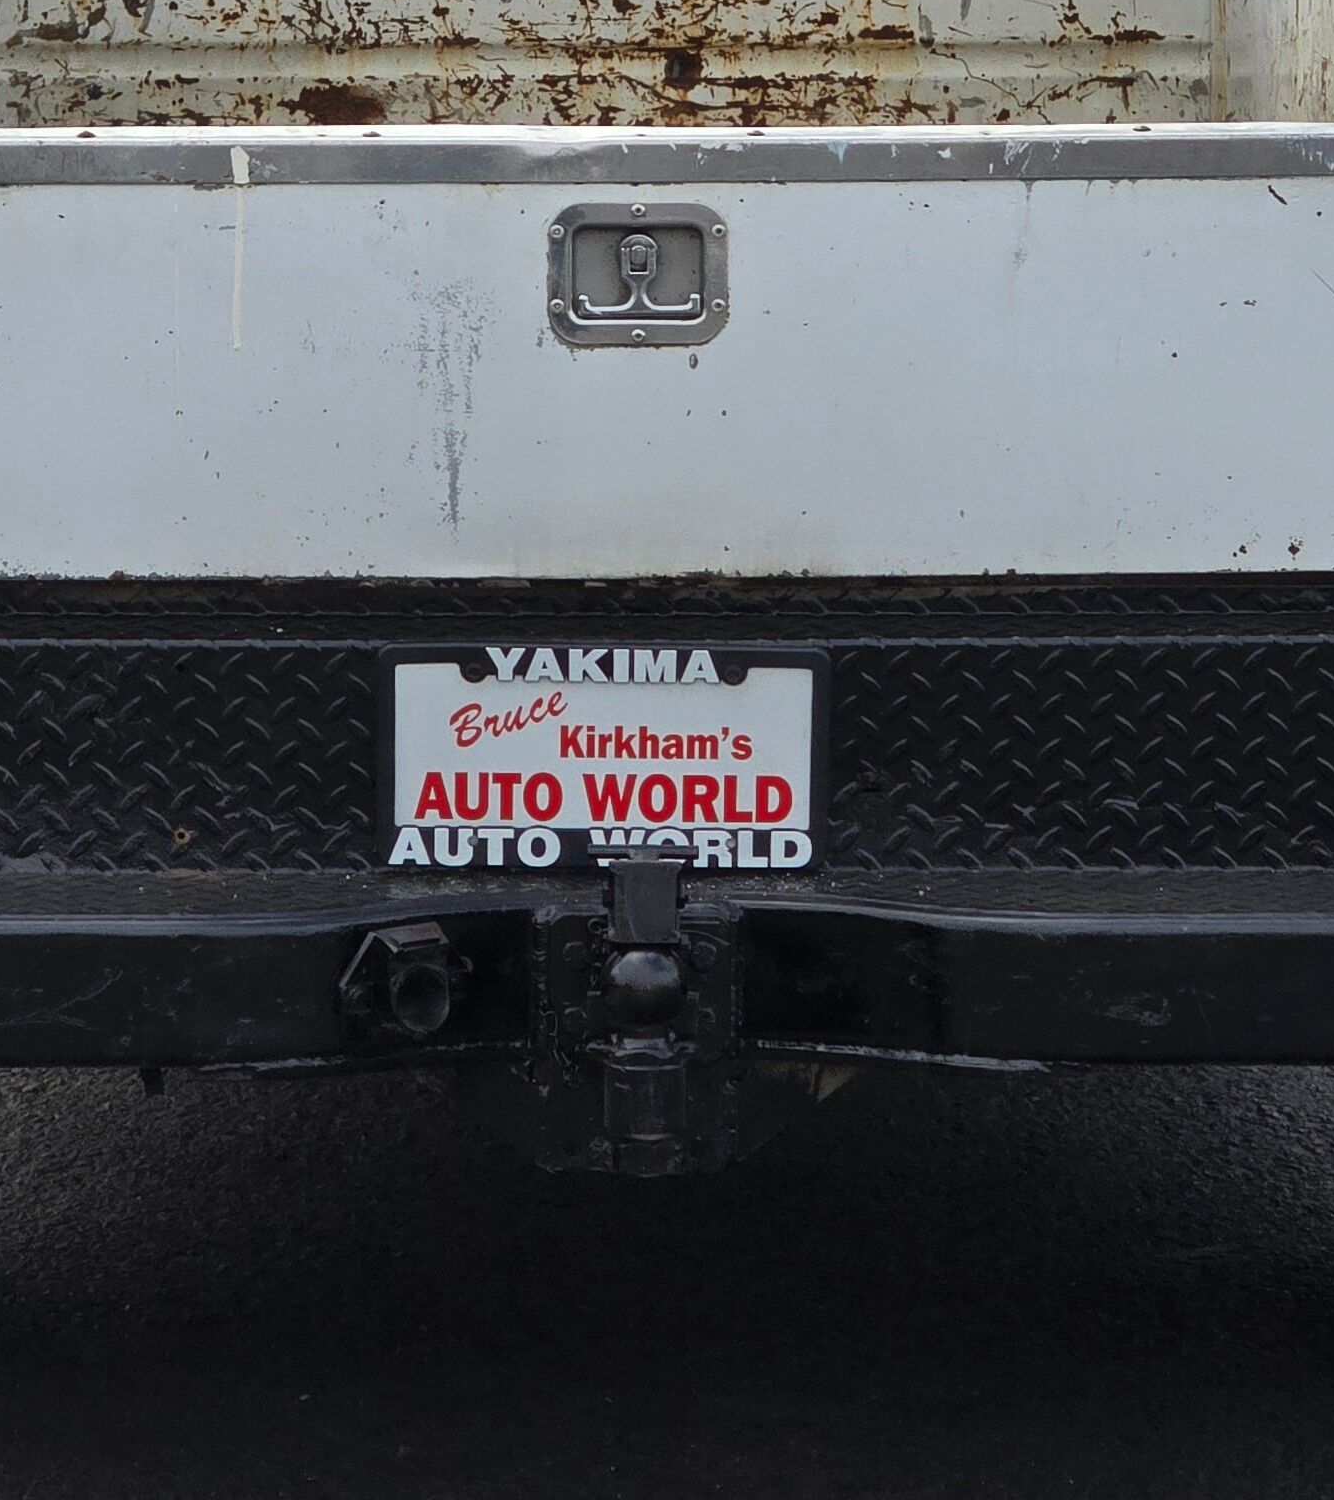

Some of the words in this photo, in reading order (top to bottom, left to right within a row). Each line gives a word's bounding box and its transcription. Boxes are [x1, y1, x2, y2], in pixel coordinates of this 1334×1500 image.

[485, 646, 720, 683] YAKIMA
[449, 691, 568, 748] Bruce
[559, 725, 753, 760] Kirkham's
[414, 772, 563, 822] AUTO
[582, 773, 793, 824] WORLD
[387, 827, 562, 867] AUTO
